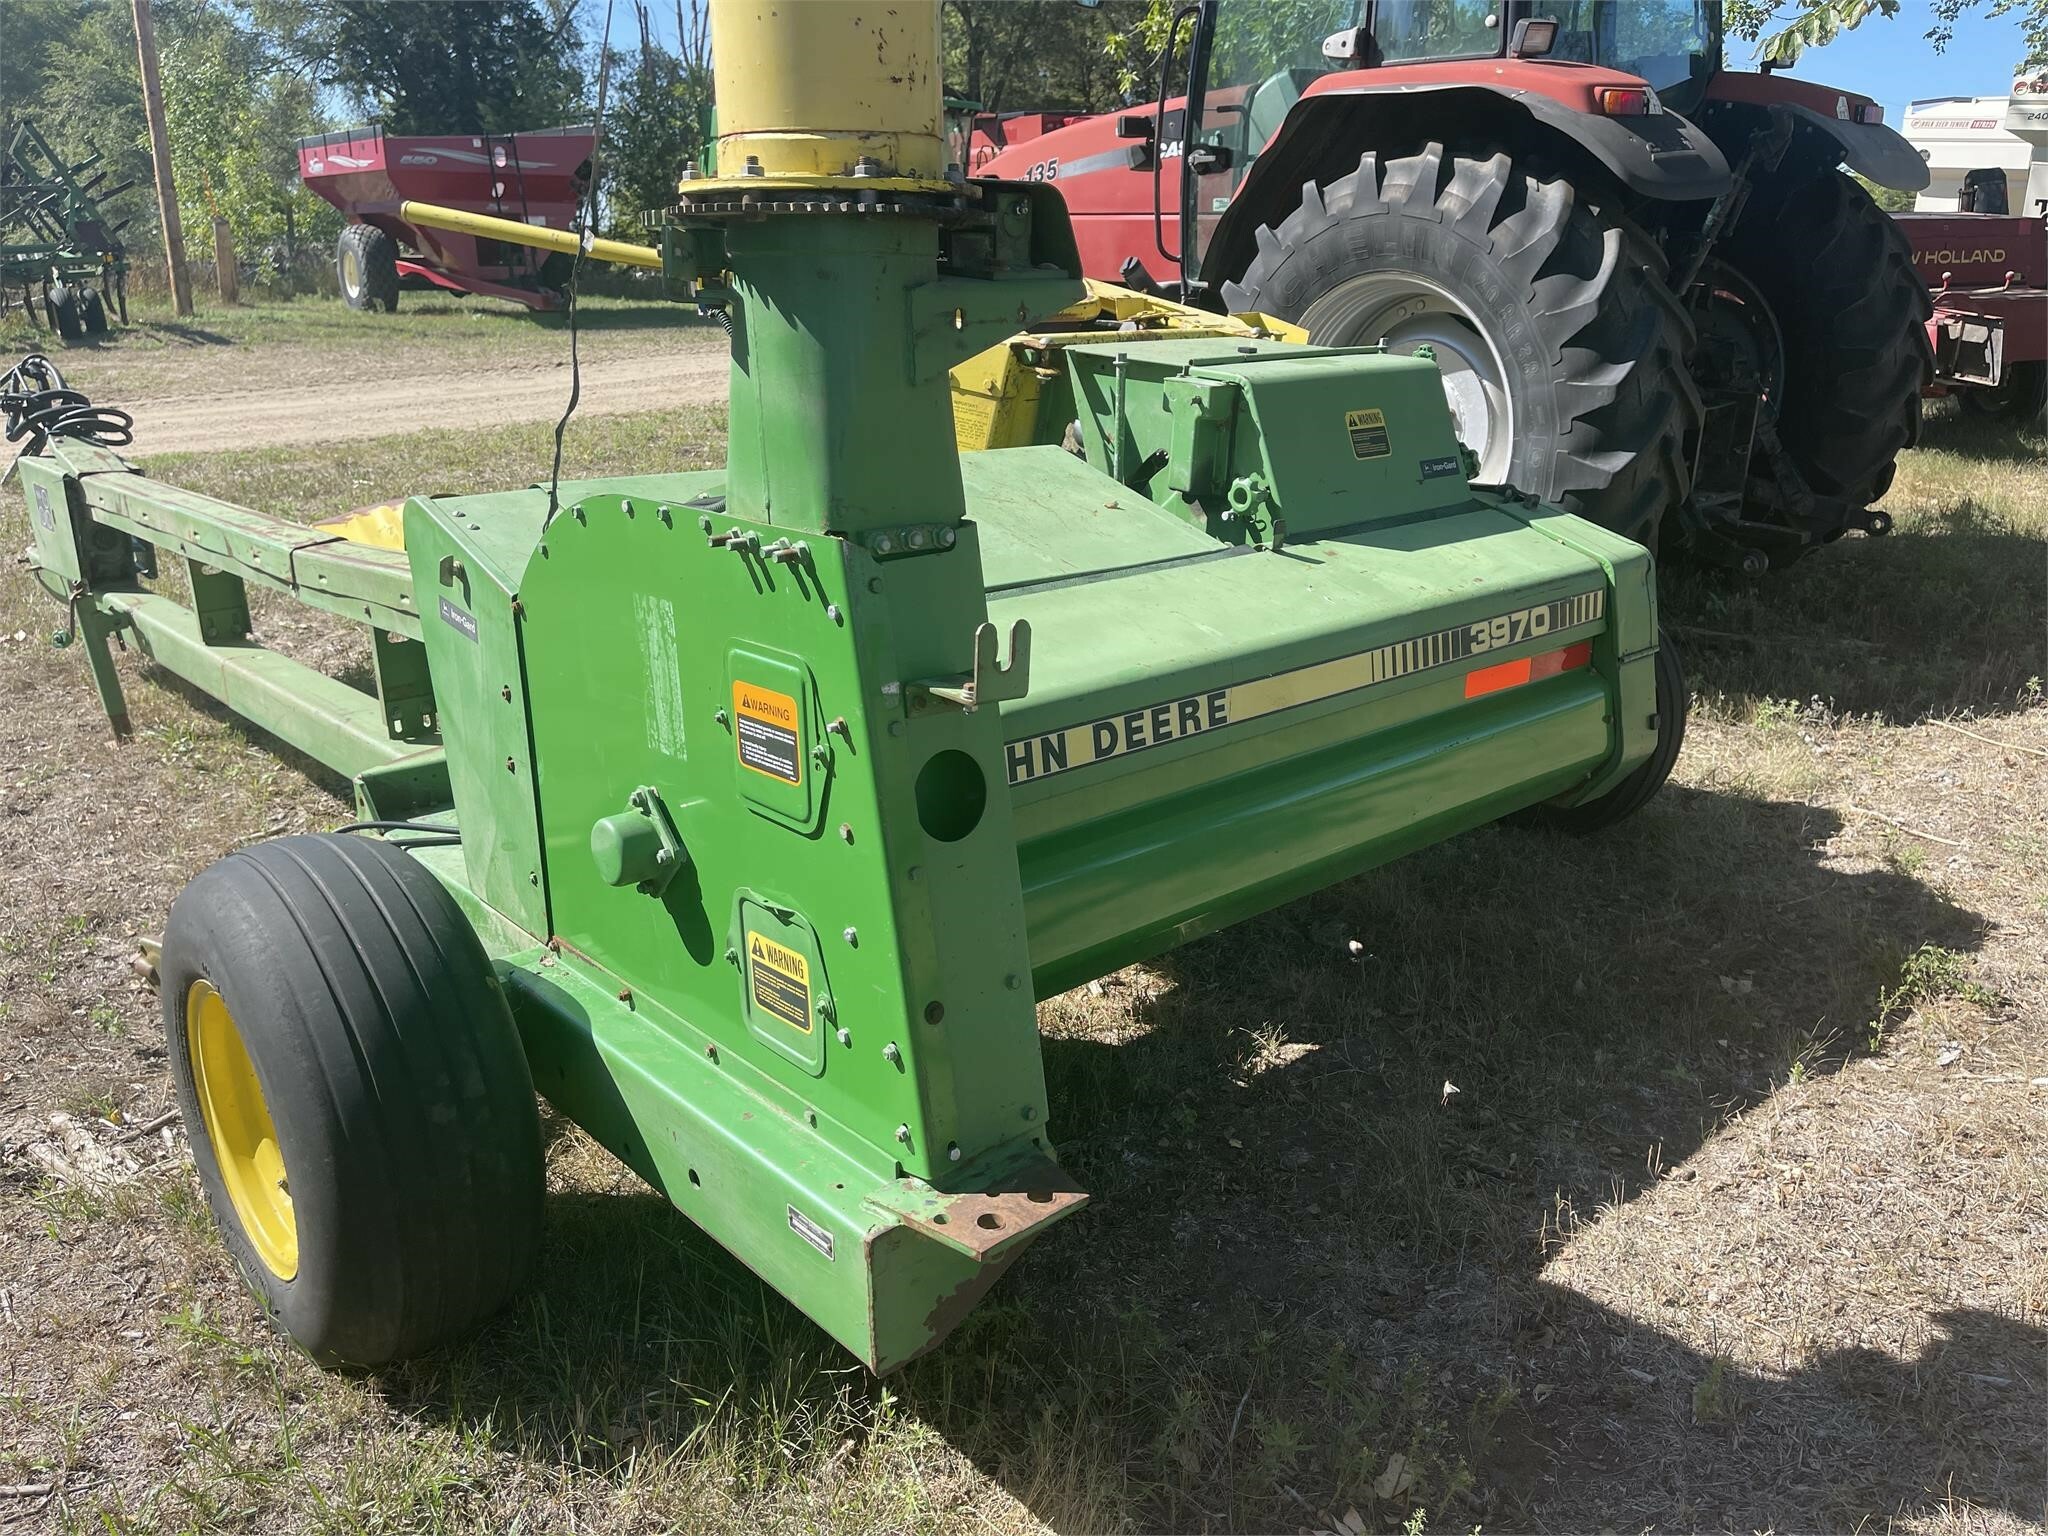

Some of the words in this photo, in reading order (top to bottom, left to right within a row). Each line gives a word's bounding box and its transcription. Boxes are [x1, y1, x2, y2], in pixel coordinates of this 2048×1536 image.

[1022, 158, 1058, 181] 135
[1925, 249, 2006, 265] HOLLAND
[1470, 605, 1551, 654] 3970
[750, 699, 790, 721] WARNING
[1092, 691, 1229, 760] DEERE
[765, 943, 805, 979] WARNING
